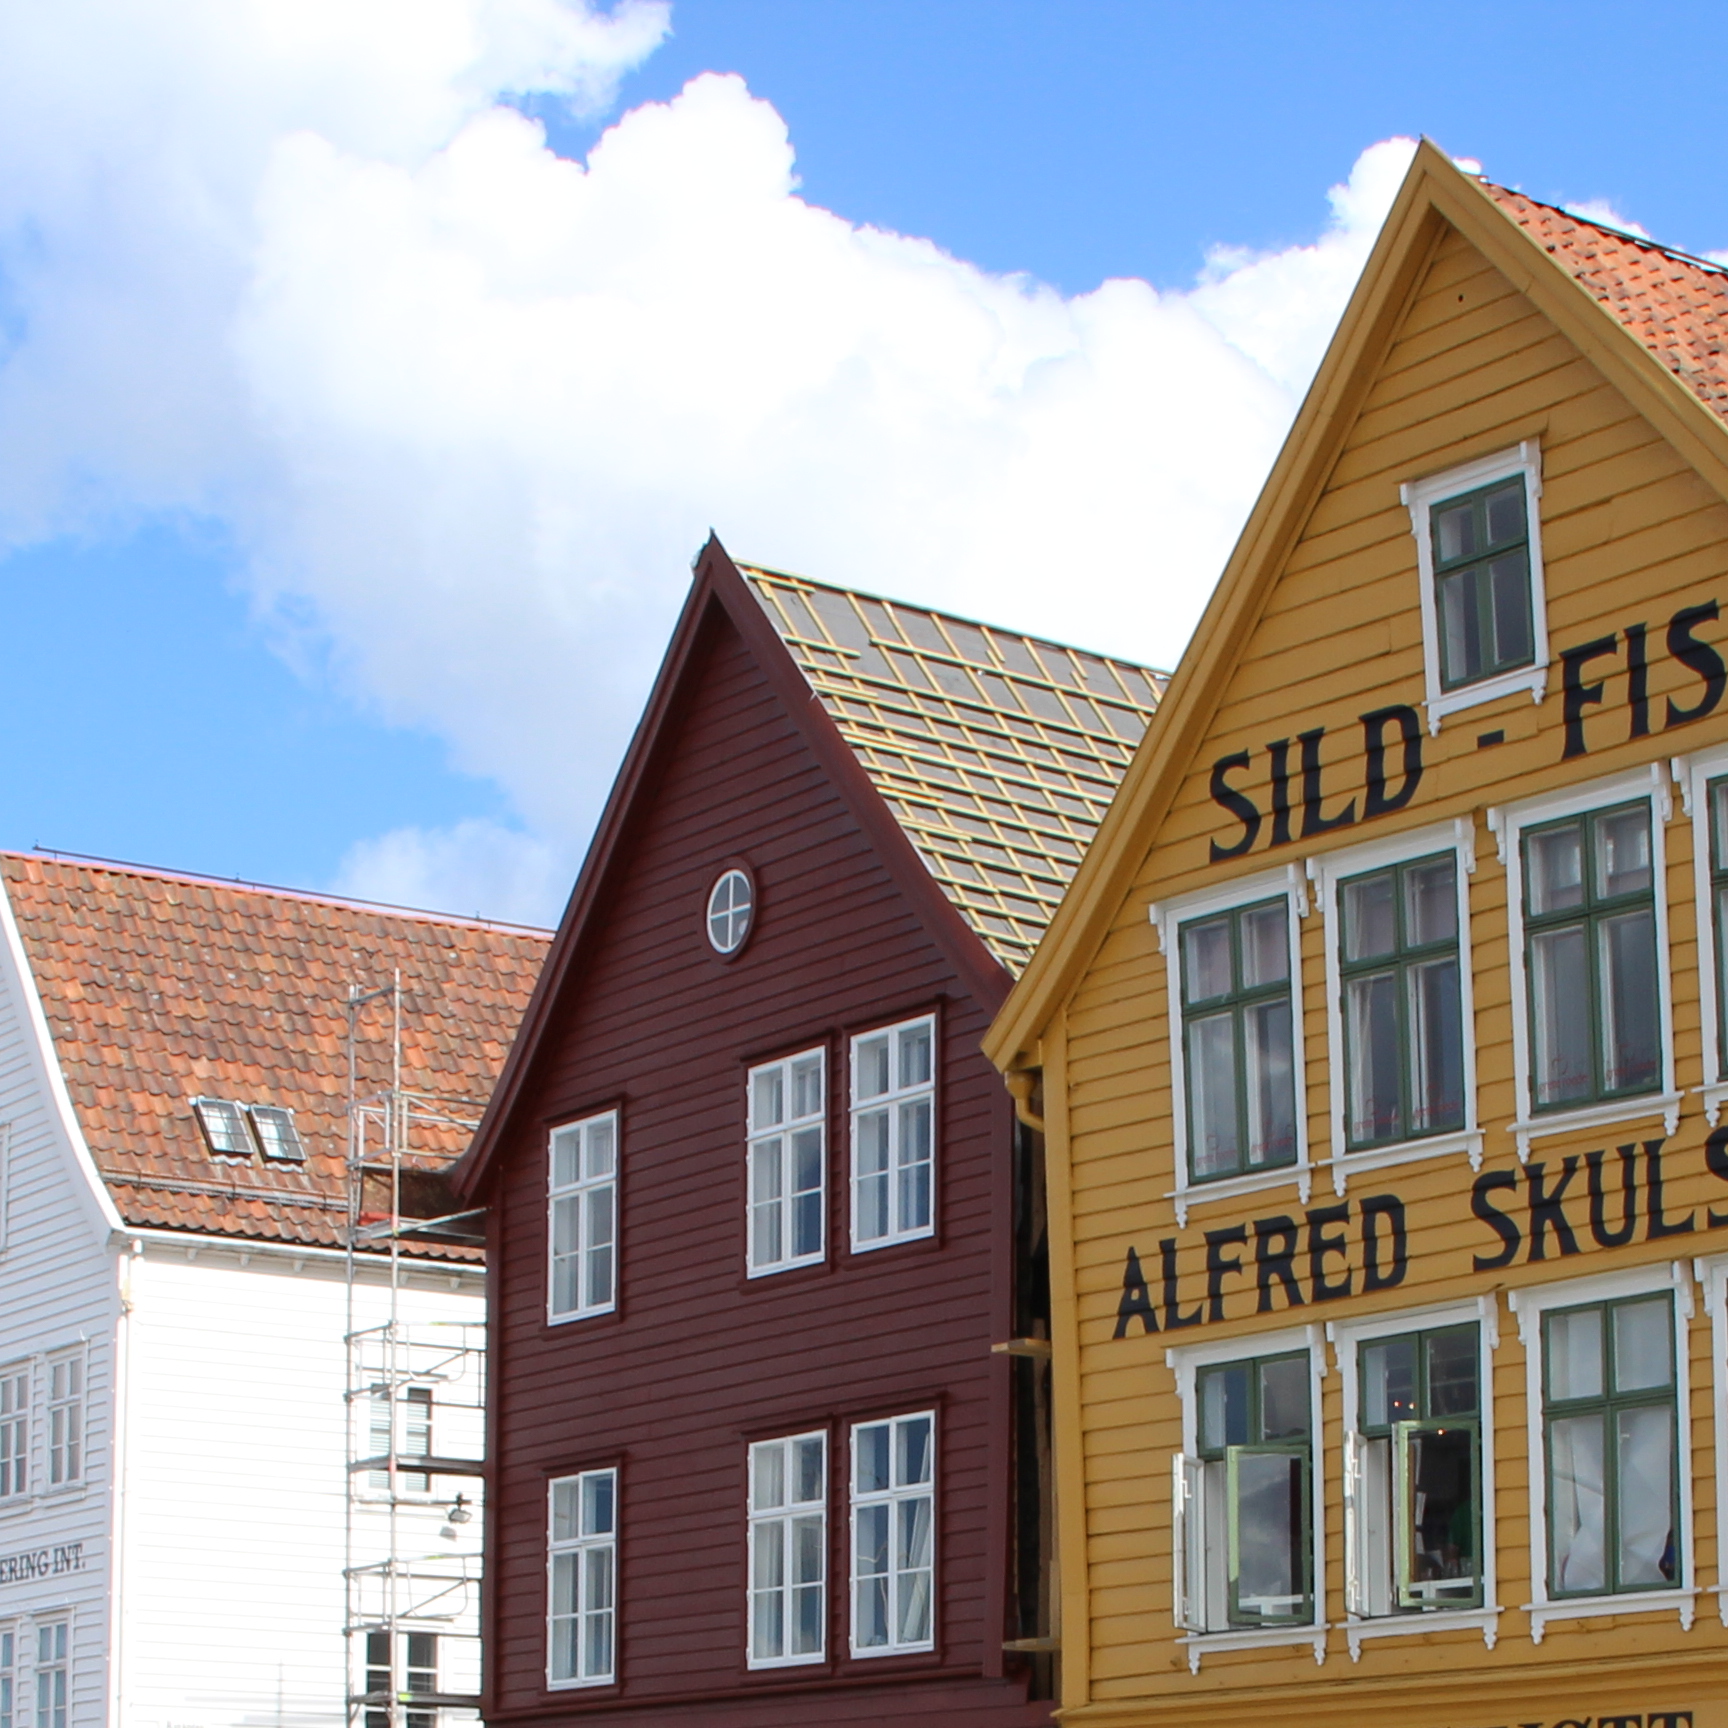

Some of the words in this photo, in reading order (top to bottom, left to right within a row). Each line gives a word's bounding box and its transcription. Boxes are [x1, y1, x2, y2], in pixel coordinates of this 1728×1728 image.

[1209, 704, 1424, 865] SILD
[1114, 1193, 1409, 1339] ALFRED
[53, 1543, 86, 1574] INT.
